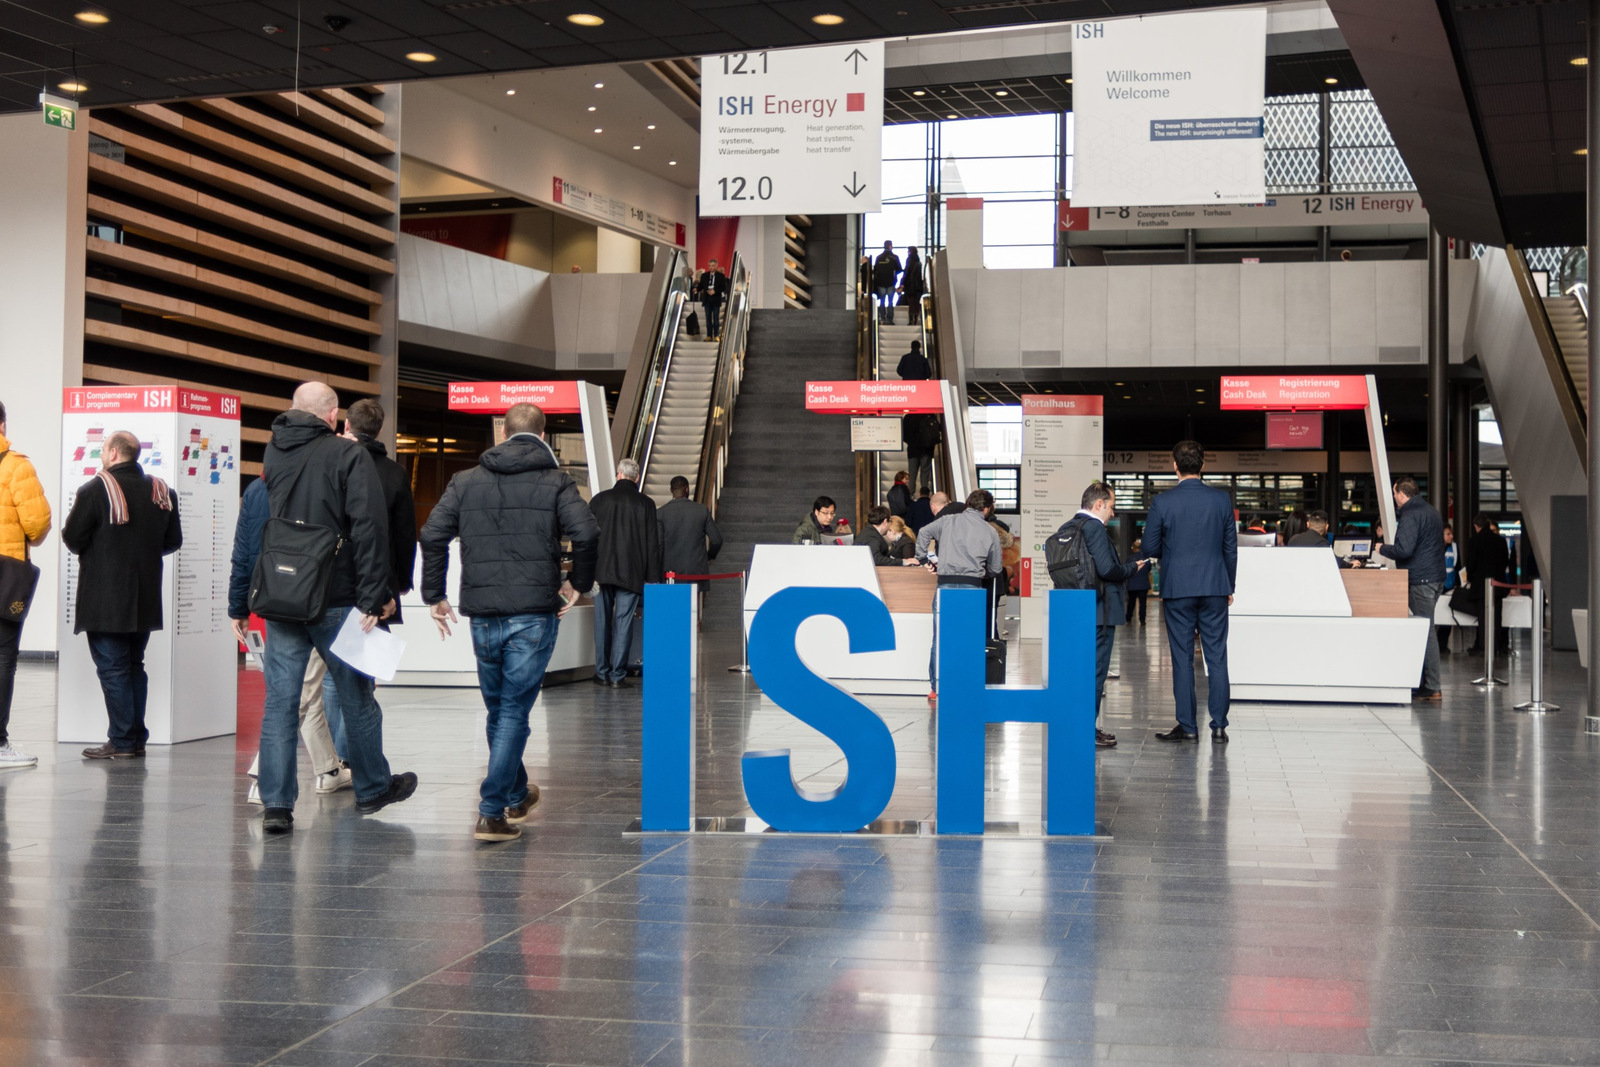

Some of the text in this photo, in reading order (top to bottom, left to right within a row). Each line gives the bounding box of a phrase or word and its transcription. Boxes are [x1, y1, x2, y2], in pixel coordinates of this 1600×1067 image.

[1076, 23, 1104, 39] ISH
[720, 51, 768, 74] 12.1
[1106, 70, 1192, 82] Willkommen
[1106, 87, 1170, 100] Welcome
[718, 94, 838, 118] ISH Energy
[718, 126, 786, 134] Wärmeerzeugung,
[825, 124, 865, 132] generation,
[1193, 129, 1225, 138] surprisingly
[718, 137, 754, 145] -systeme,
[824, 135, 855, 143] systems,
[718, 147, 780, 156] Wärmeübergabe
[718, 176, 773, 201] 12.0
[1303, 196, 1414, 214] 12 ISH Energy
[1223, 378, 1340, 388] Kasse Registrierung
[500, 384, 554, 393] Registrierung
[861, 384, 916, 393] Registrierung
[87, 390, 171, 408] Complementary ISH
[861, 394, 908, 404] Registration
[1280, 390, 1330, 399] Registration
[190, 393, 236, 414] Rahmen- ISH
[500, 396, 546, 404] Registration
[1024, 399, 1075, 408] Portalhaus
[190, 402, 211, 411] programm
[642, 584, 1096, 836] ISH
